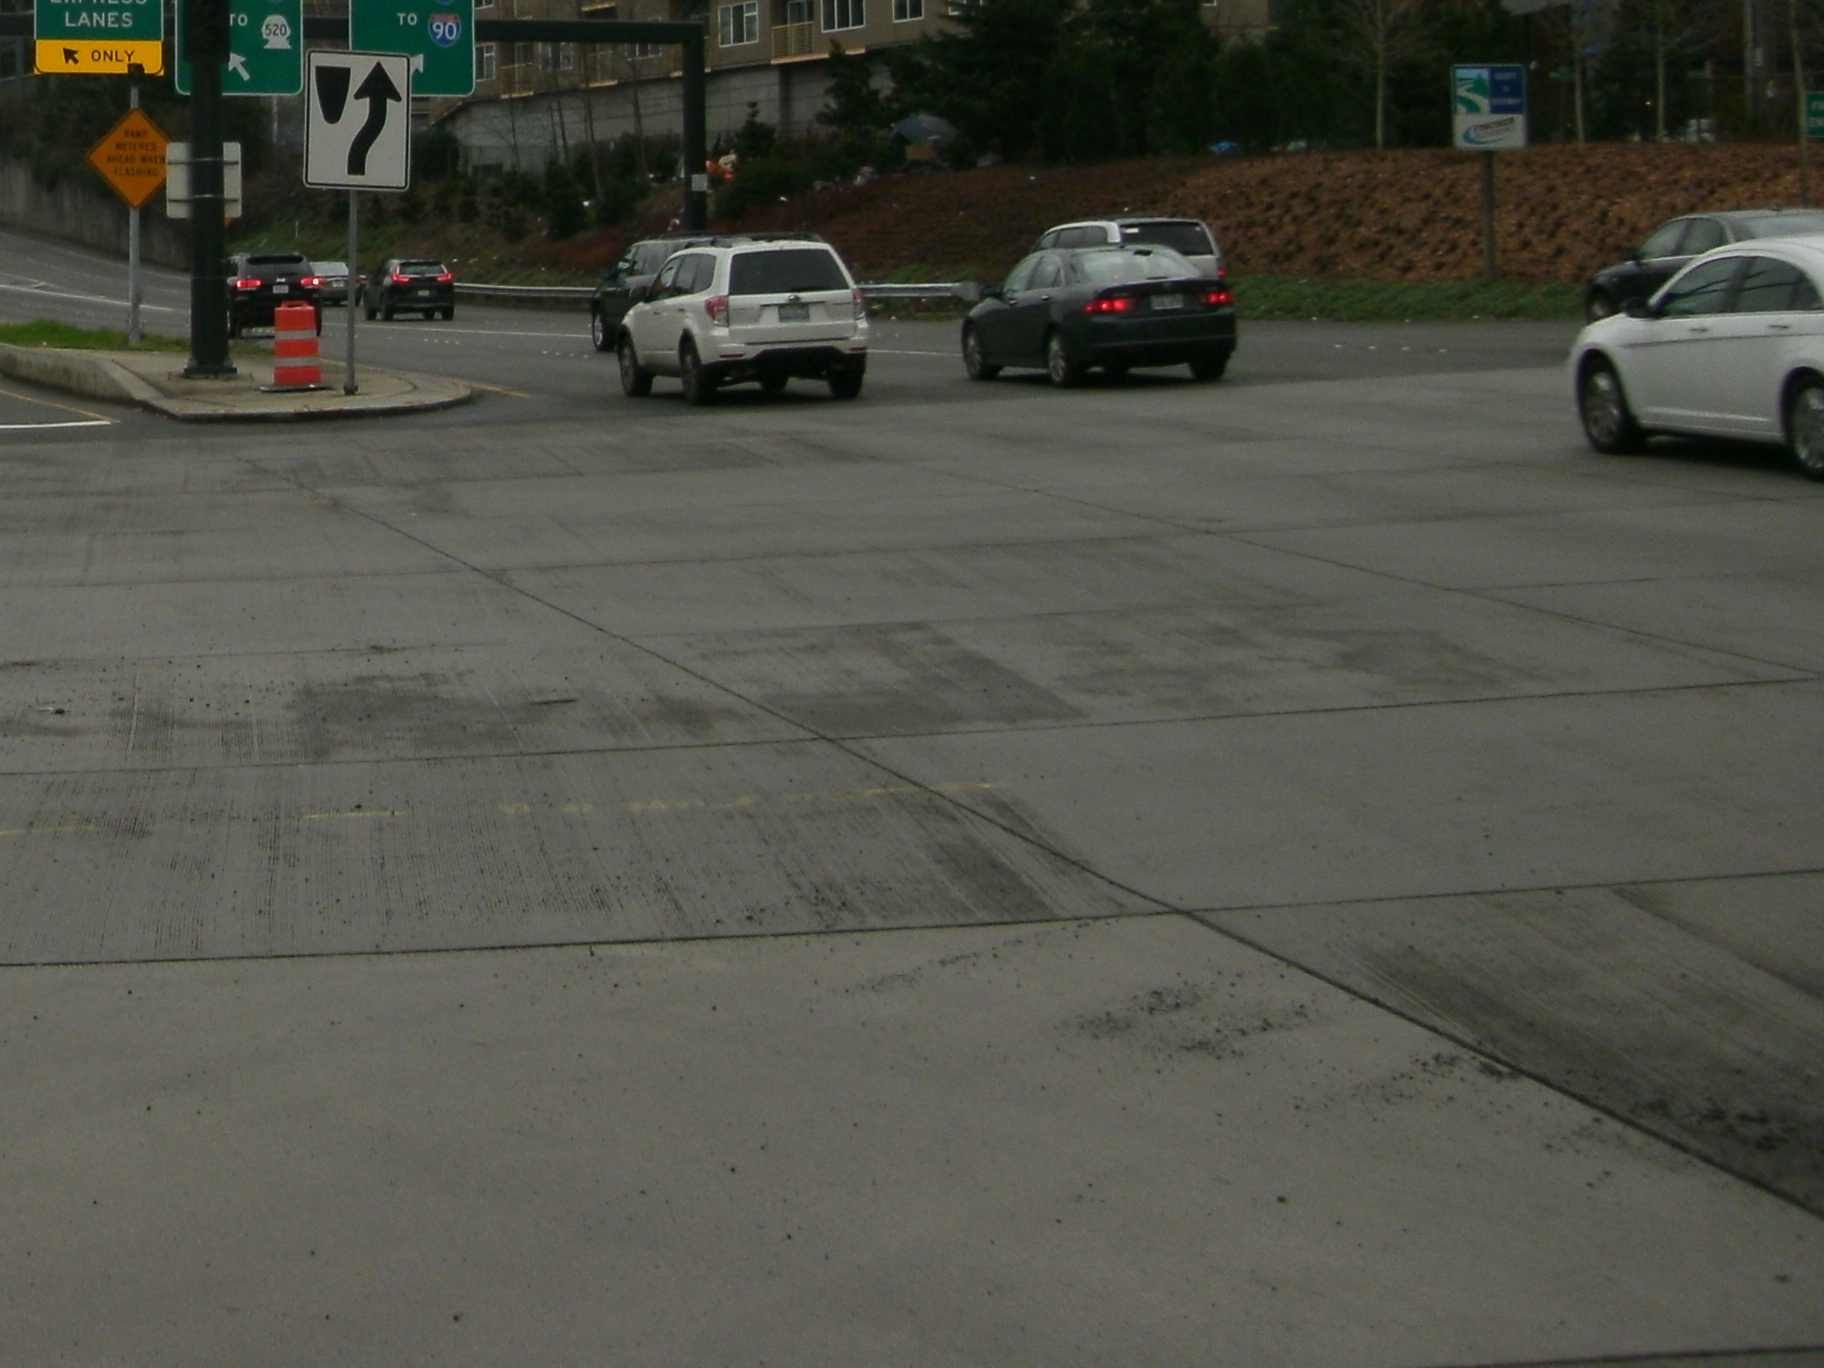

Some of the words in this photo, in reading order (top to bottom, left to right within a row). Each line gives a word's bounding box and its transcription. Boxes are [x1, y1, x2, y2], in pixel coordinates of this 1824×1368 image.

[65, 11, 133, 28] LANES
[397, 12, 418, 26] TO
[432, 22, 457, 40] 90
[264, 23, 288, 37] 520
[91, 49, 135, 63] ONLY
[115, 142, 156, 151] METERED
[107, 154, 135, 163] AHEAD
[114, 168, 158, 177] FLASHING
